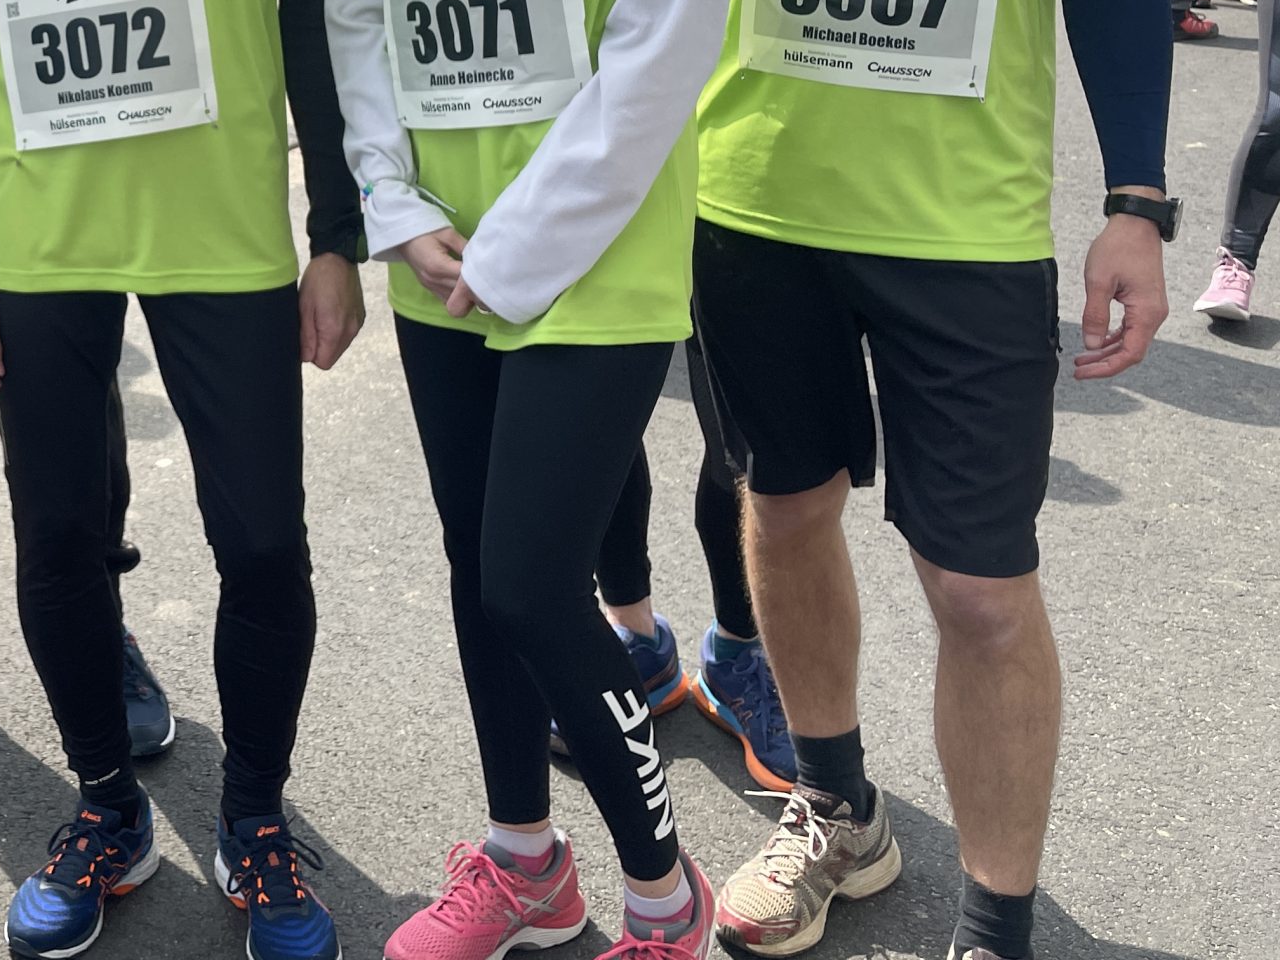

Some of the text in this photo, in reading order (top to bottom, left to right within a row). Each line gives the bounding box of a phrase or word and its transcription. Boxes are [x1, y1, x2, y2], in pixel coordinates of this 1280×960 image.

[31, 6, 171, 85] 3072
[802, 25, 916, 50] Michael Boekels
[784, 49, 853, 70] hülsemann
[430, 67, 514, 87] Anne Heinecke
[58, 81, 153, 105] Nikolaus Koemm
[421, 99, 471, 113] hülsemann
[49, 114, 106, 131] hülsemann
[602, 689, 674, 840] NIKE
